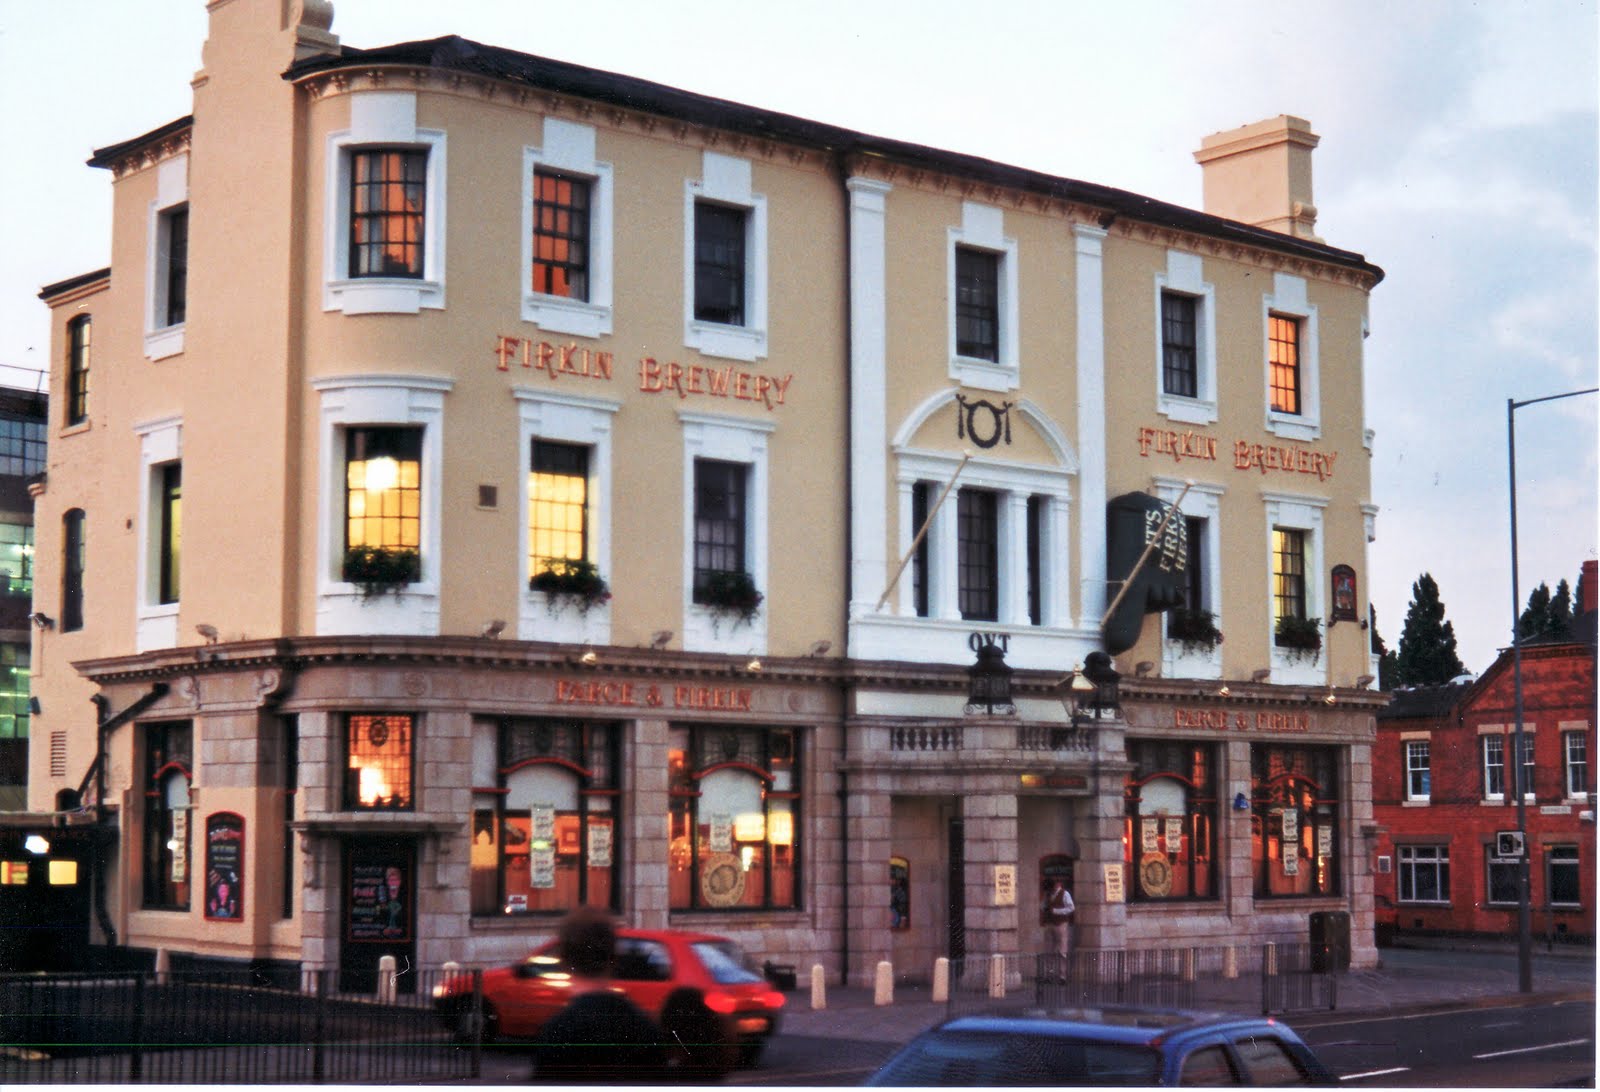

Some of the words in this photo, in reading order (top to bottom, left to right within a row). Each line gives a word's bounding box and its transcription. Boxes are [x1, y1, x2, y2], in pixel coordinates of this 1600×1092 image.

[496, 336, 613, 380] FIRKIN
[638, 357, 793, 411] BREWERY
[1138, 427, 1217, 463] FIRKIN
[1234, 440, 1338, 482] BREWERY
[1145, 509, 1162, 549] IT'S
[556, 679, 634, 707] FARCE
[646, 683, 663, 708] &
[674, 683, 751, 711] FIRKIN
[1175, 708, 1229, 731] FARCE
[1236, 711, 1248, 731] &
[1256, 710, 1309, 733] FIRKIN
